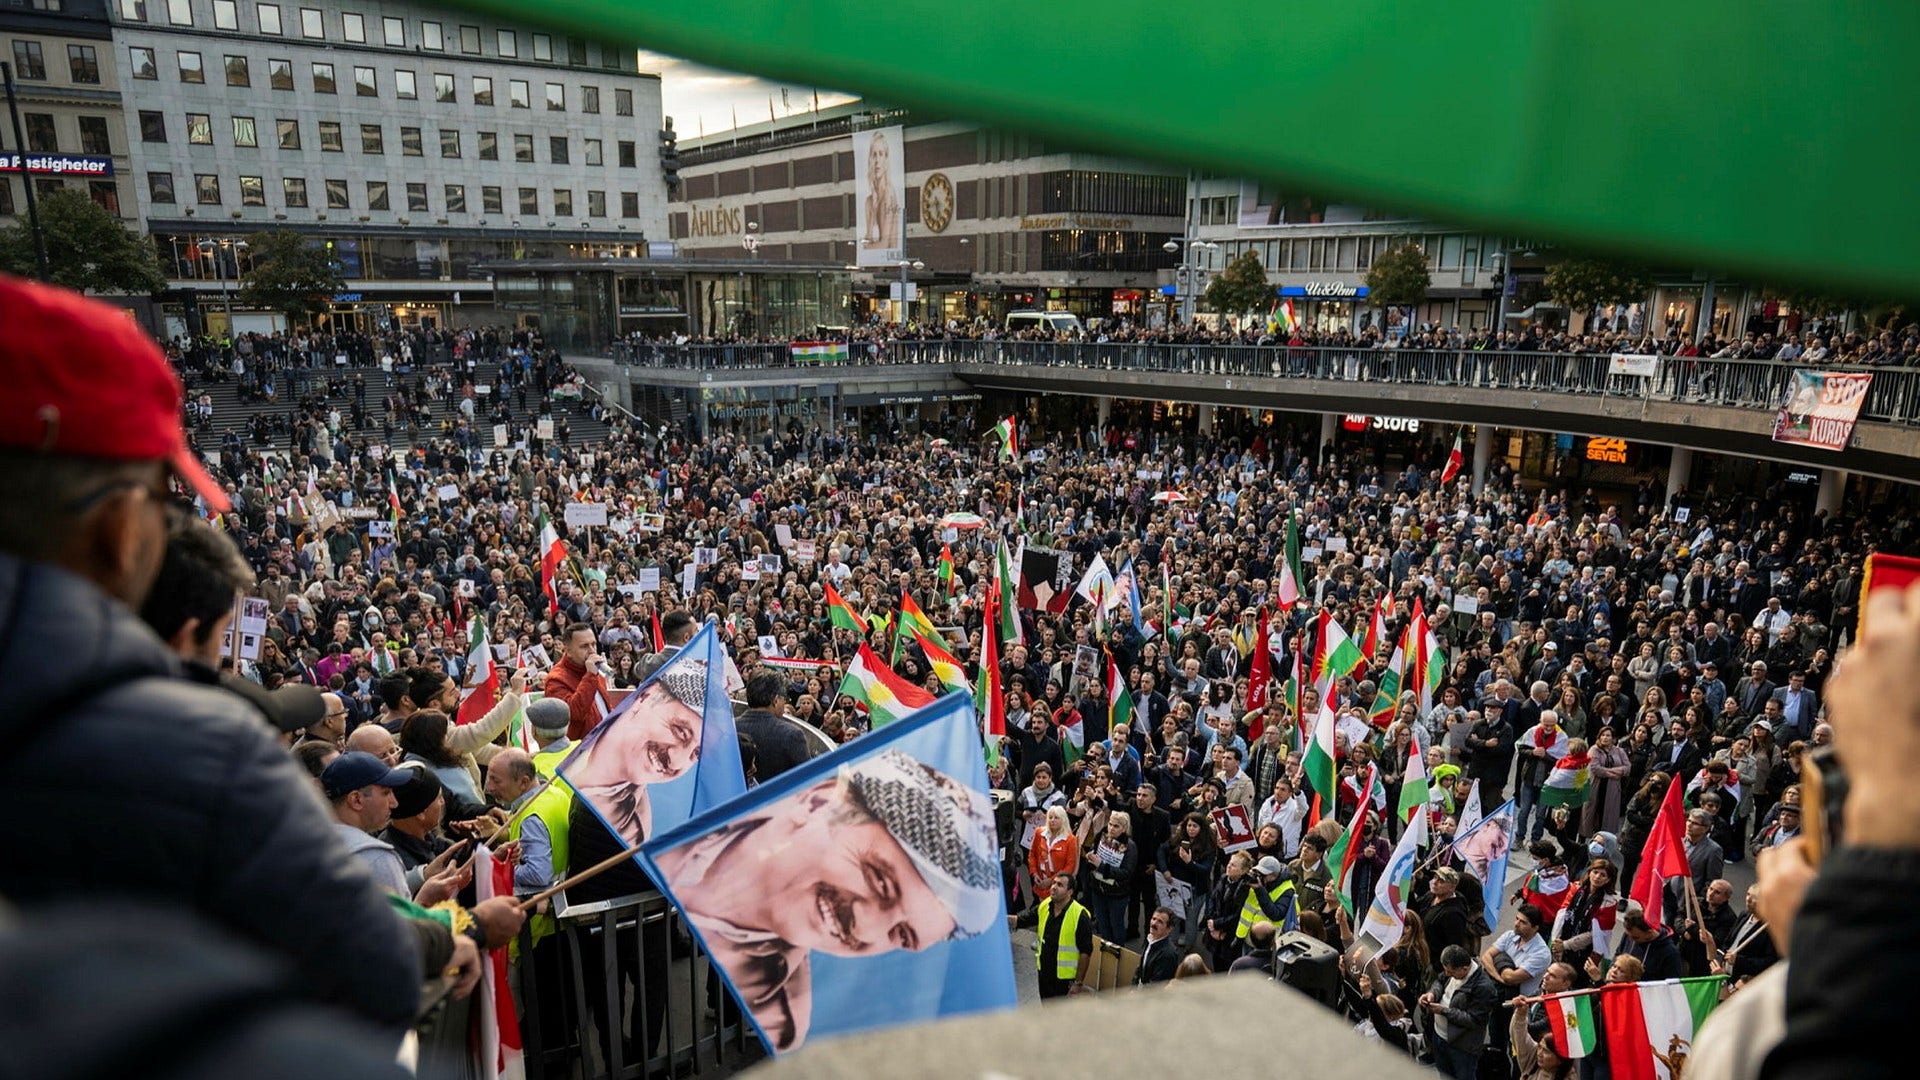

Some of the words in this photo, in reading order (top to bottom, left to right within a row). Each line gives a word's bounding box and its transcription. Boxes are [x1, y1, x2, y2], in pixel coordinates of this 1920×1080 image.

[691, 204, 741, 237] ÅHLÉNS
[1822, 377, 1868, 406] STOP
[802, 403, 817, 414] SL
[1372, 416, 1419, 433] Store
[1809, 418, 1853, 444] KURDS
[1586, 449, 1626, 463] SEVEN
